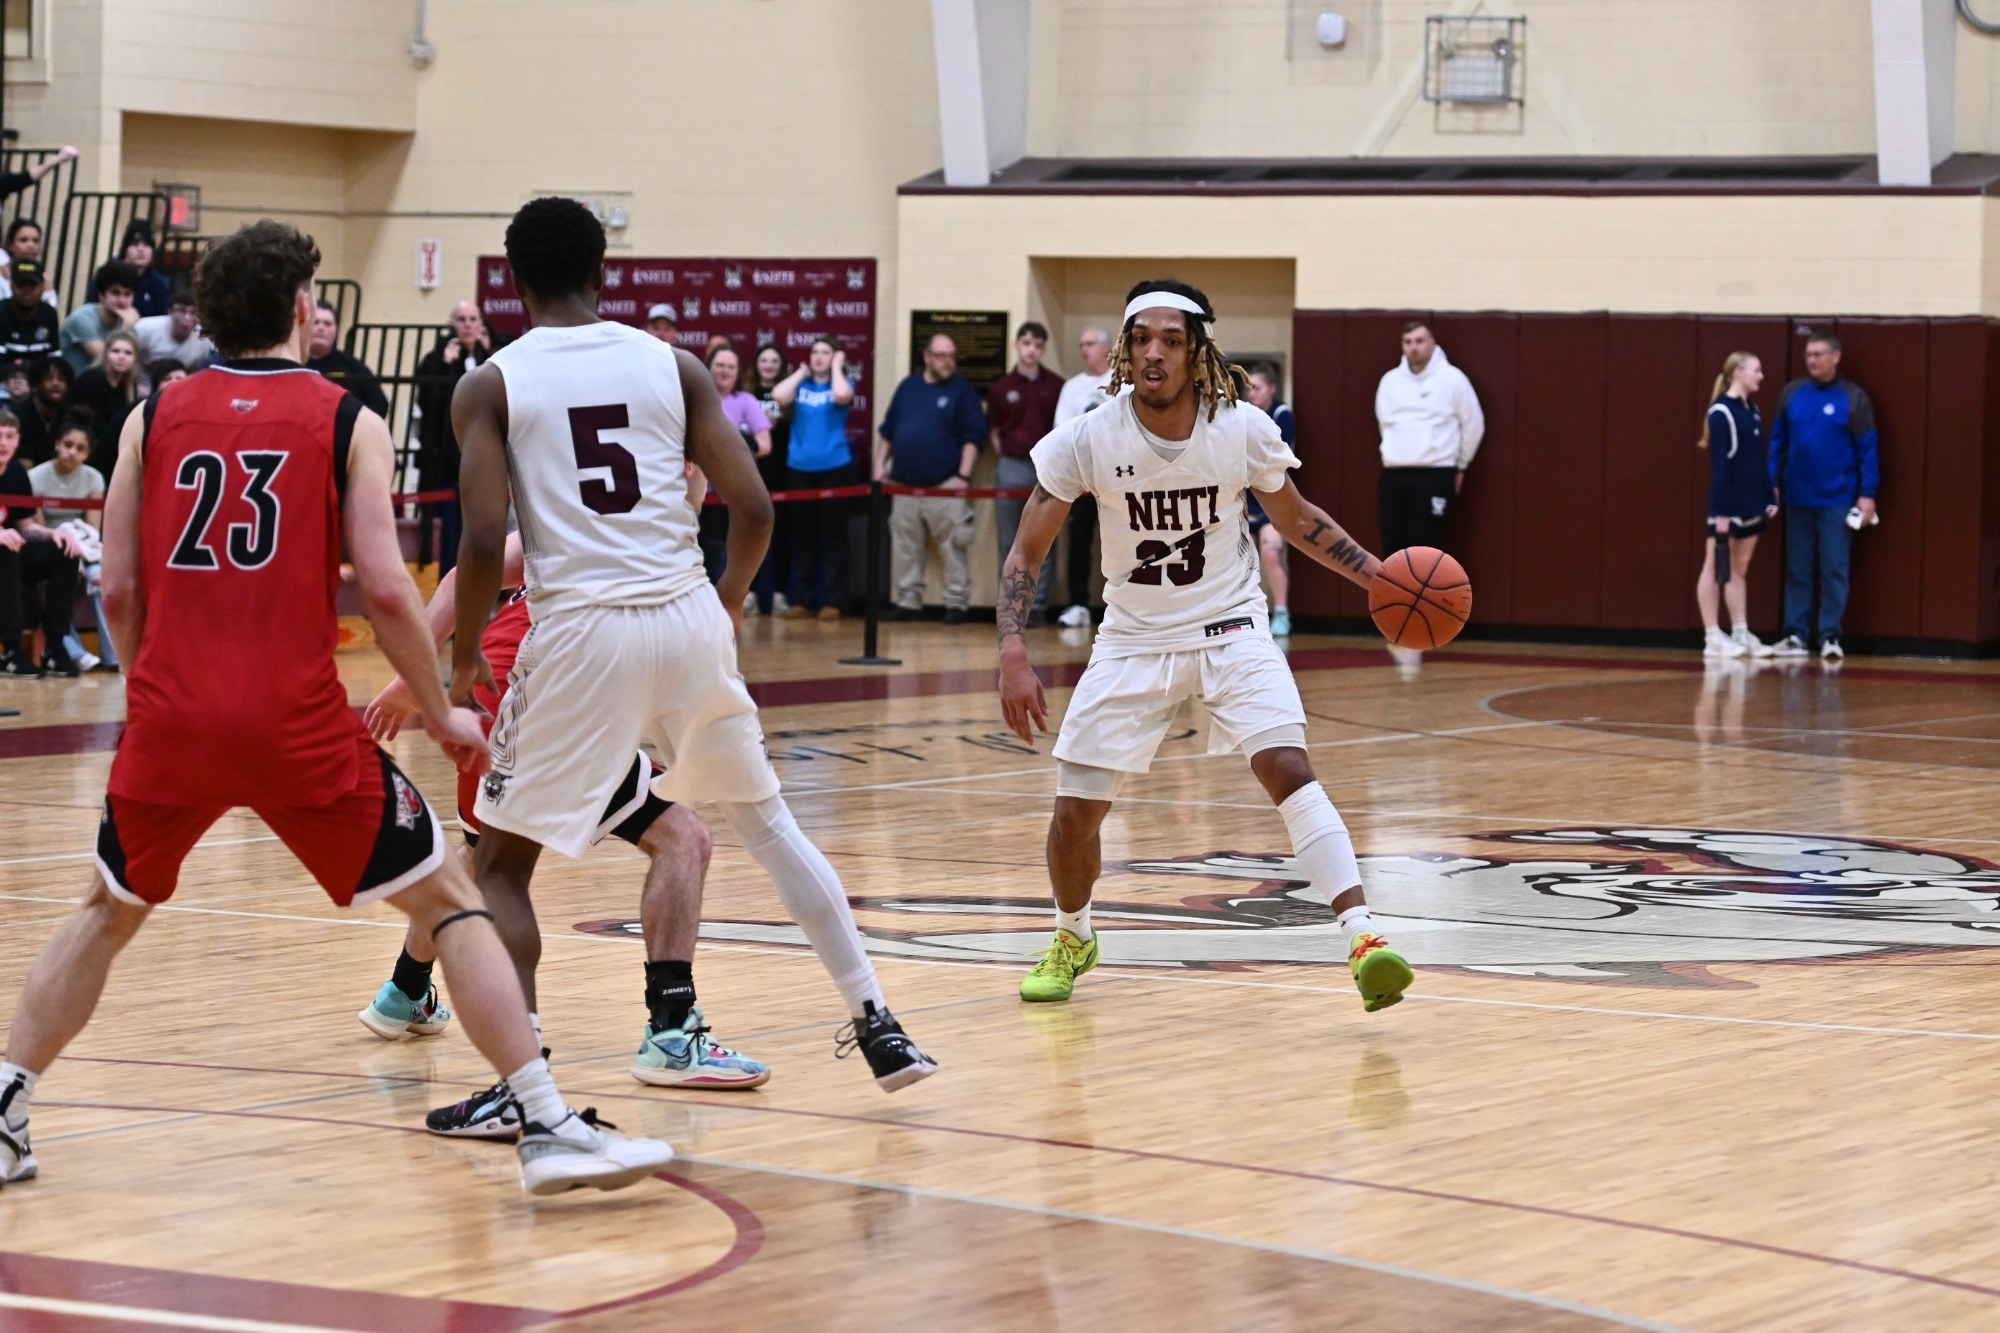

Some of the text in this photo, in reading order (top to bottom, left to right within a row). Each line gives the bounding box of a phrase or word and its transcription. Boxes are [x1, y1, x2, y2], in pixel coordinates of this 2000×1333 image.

[567, 403, 642, 515] 5
[166, 450, 290, 570] 23
[1125, 485, 1220, 531] NHTI
[1303, 518, 1333, 546] I
[1128, 529, 1205, 586] 23
